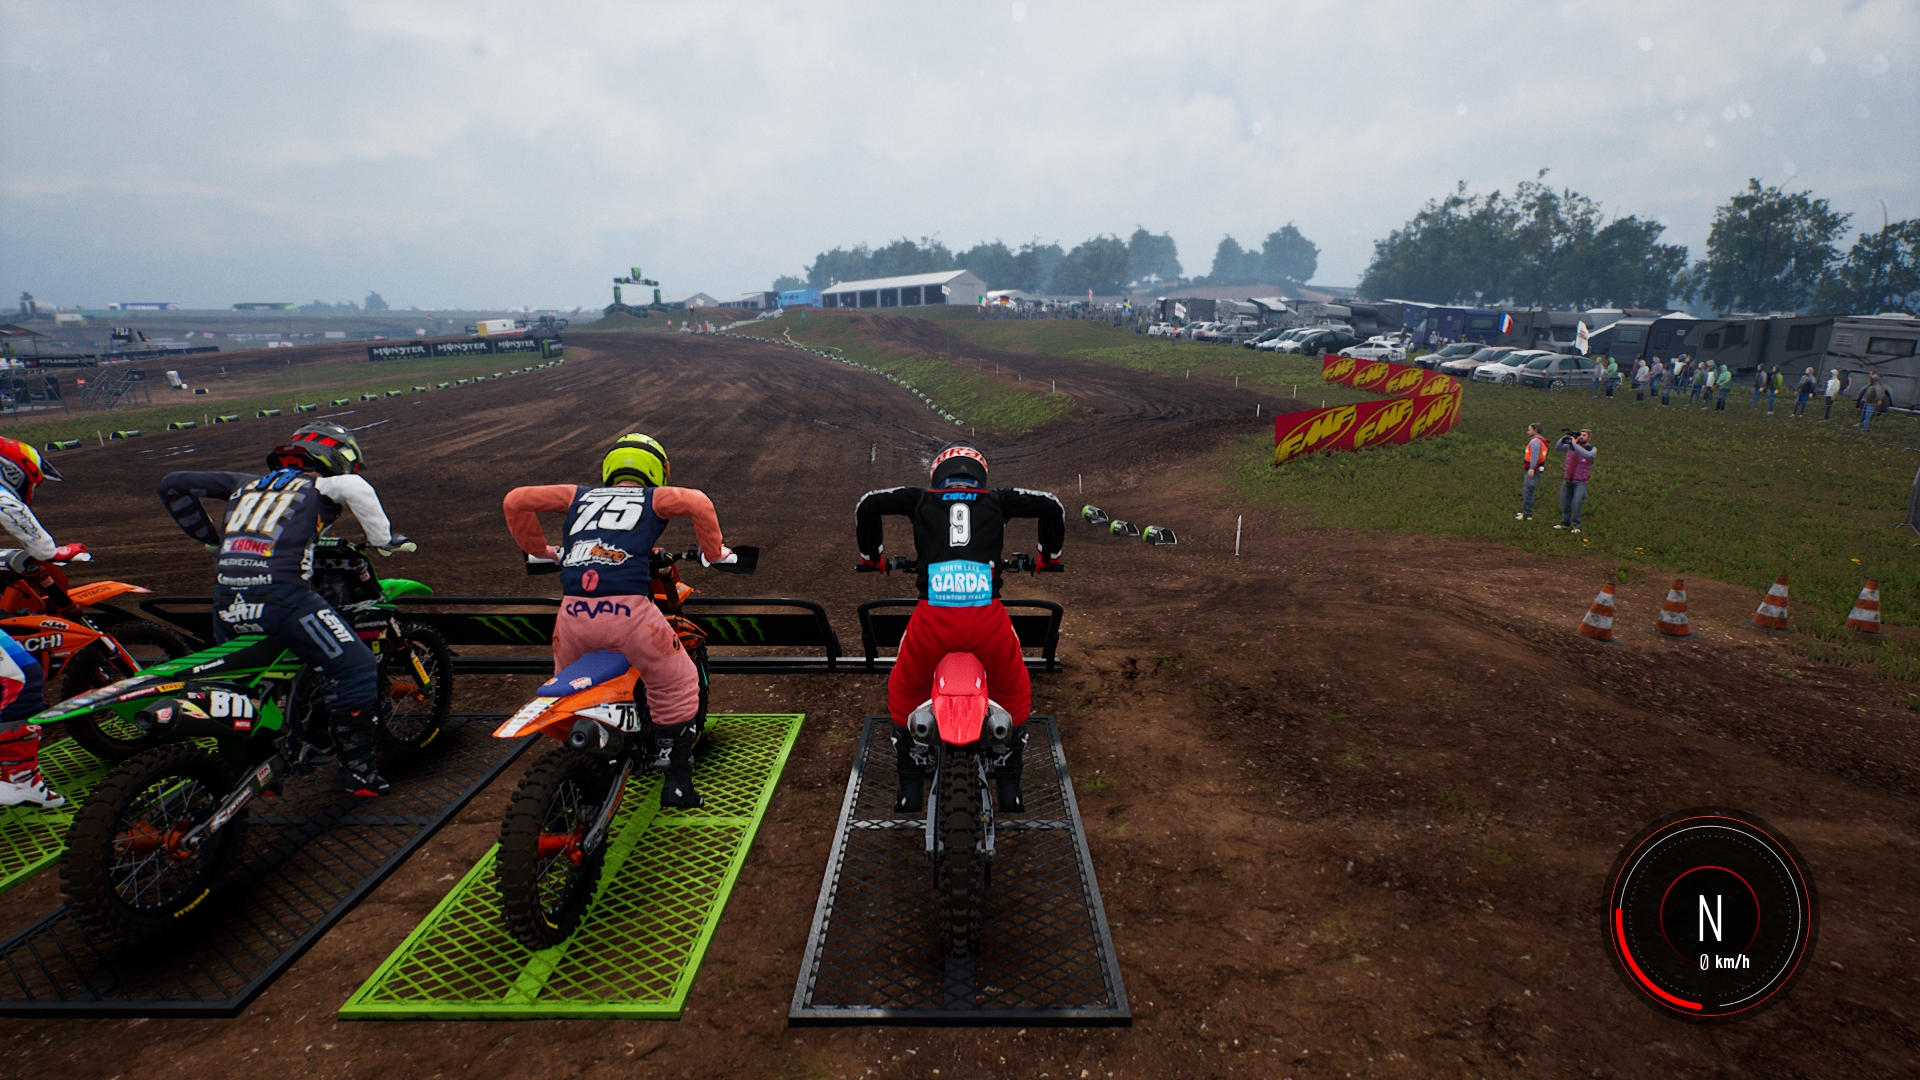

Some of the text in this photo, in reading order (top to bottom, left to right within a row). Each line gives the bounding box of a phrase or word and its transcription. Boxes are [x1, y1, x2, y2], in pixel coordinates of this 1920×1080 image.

[373, 345, 426, 356] MONSTER
[437, 342, 487, 352] MONSTER
[498, 340, 535, 348] MONSTER
[225, 492, 296, 534] 811
[568, 495, 645, 536] 75
[949, 502, 971, 548] 9
[931, 573, 990, 593] GARDA
[210, 691, 254, 718] 811
[615, 704, 635, 731] 75
